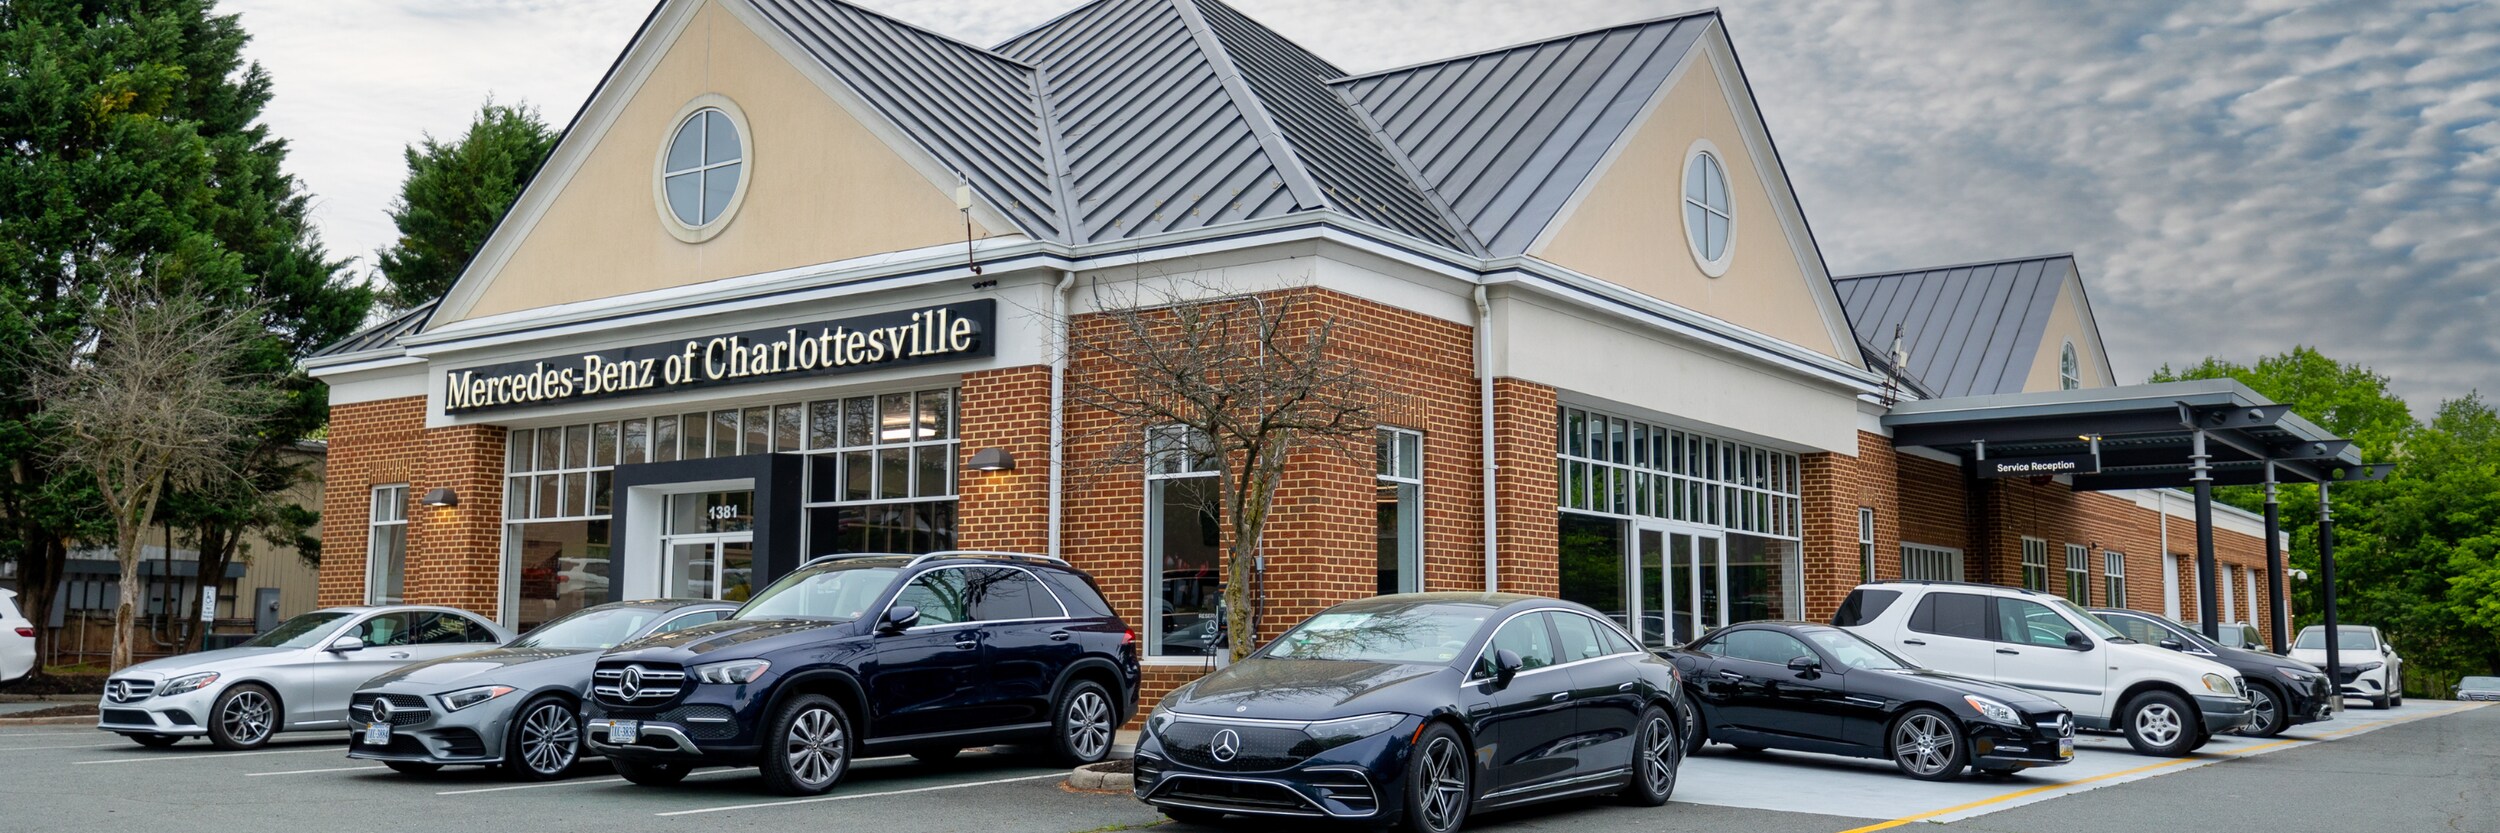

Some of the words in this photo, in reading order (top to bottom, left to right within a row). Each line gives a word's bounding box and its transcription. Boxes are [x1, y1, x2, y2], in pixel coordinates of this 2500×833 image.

[446, 354, 656, 410] Mercedes-Benz
[664, 341, 697, 385] of
[705, 307, 971, 380] Charlottesville
[1997, 462, 2029, 472] Service
[2031, 460, 2075, 472] Reception
[709, 504, 738, 520] 1381
